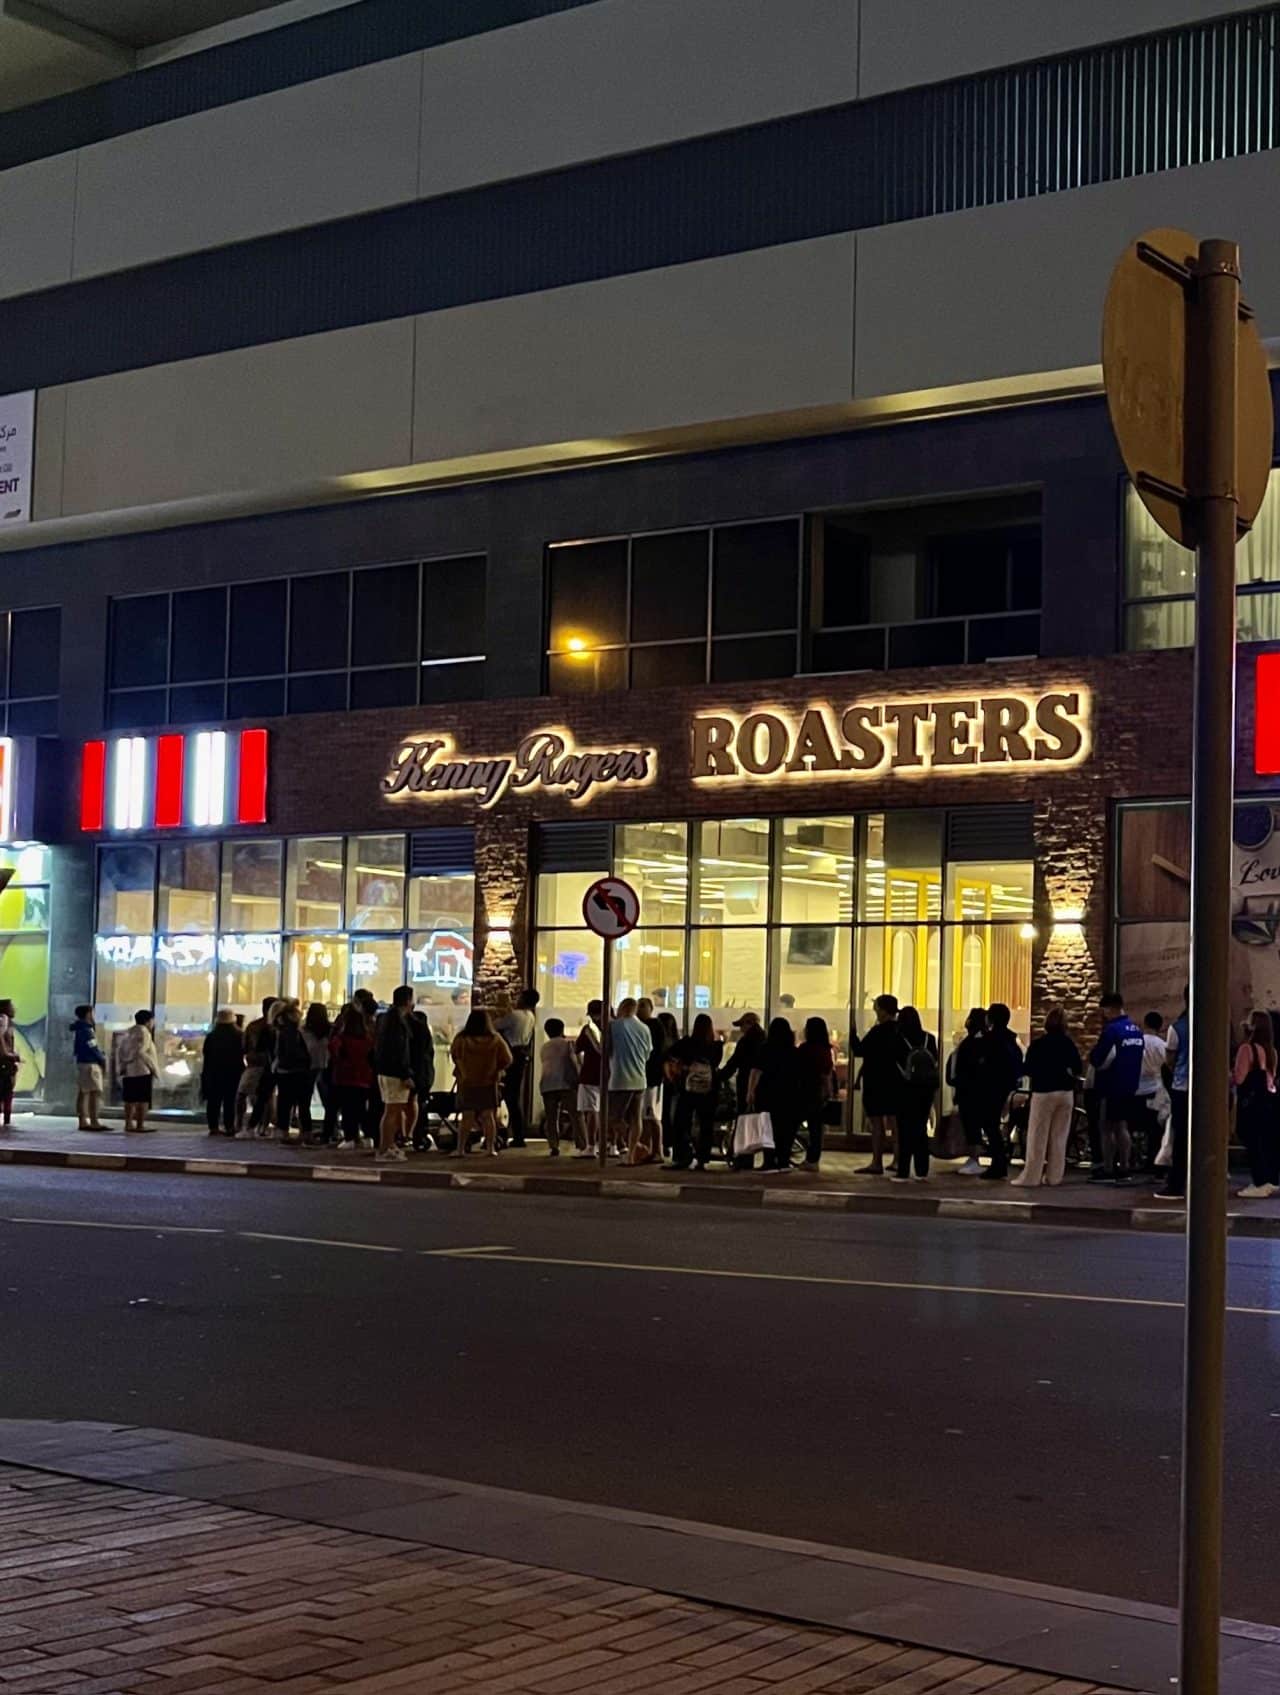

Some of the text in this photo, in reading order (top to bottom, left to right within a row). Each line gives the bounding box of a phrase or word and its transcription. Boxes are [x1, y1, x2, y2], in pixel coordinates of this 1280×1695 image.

[380, 693, 1083, 806] Kenny Rogers ROASTERS
